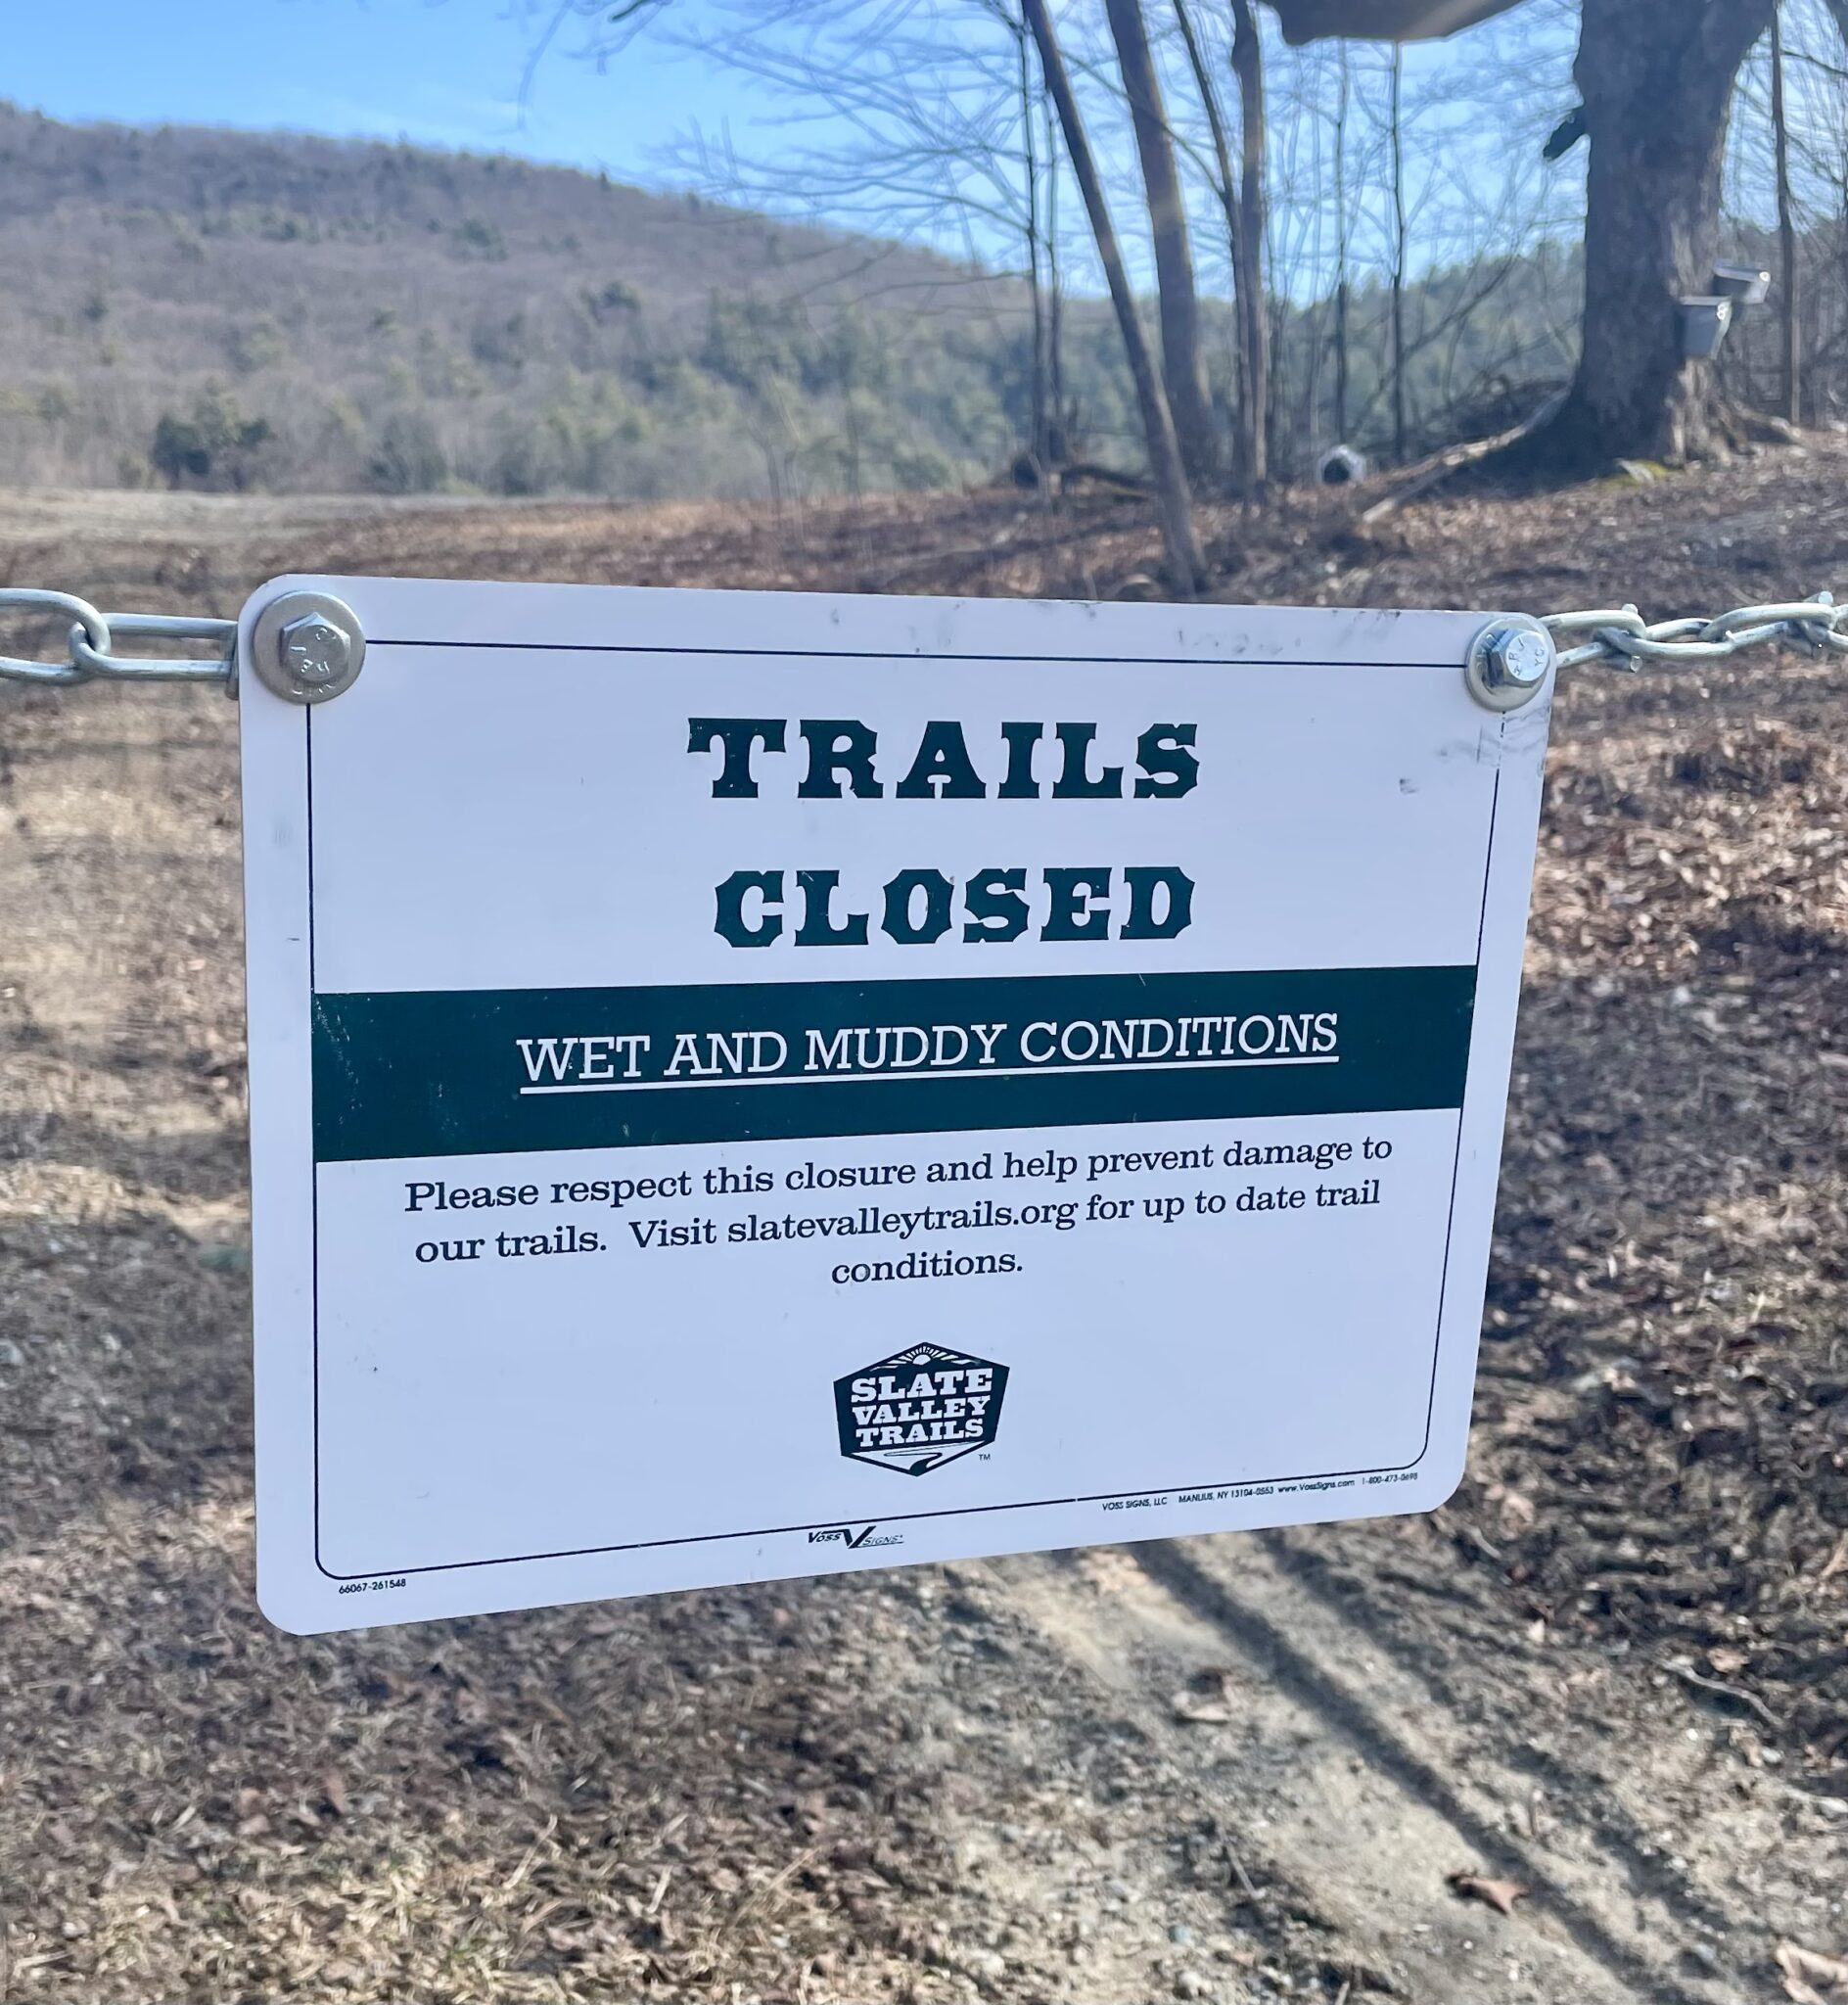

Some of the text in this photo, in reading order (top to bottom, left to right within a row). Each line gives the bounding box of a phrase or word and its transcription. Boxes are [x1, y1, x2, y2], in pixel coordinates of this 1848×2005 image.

[687, 717, 1200, 800] TRAILS
[714, 865, 1196, 949] CLOSED
[517, 1012, 1338, 1082] WET AND MUDDY CONDITIONS
[404, 1136, 1393, 1212] Please respect this closure and help prevent damage to
[415, 1179, 1380, 1263] our trails. Visit slatevalleytrails.org for up to date trail
[832, 1249, 1024, 1284] conditions.
[851, 1368, 994, 1403] SLATE
[852, 1395, 992, 1425] VALLEY
[855, 1419, 984, 1448] TRAILS
[1102, 1501, 1124, 1512] VOSS
[1153, 1496, 1168, 1507] LLC
[1217, 1490, 1229, 1500] NY
[338, 1578, 407, 1595] 66067-261548
